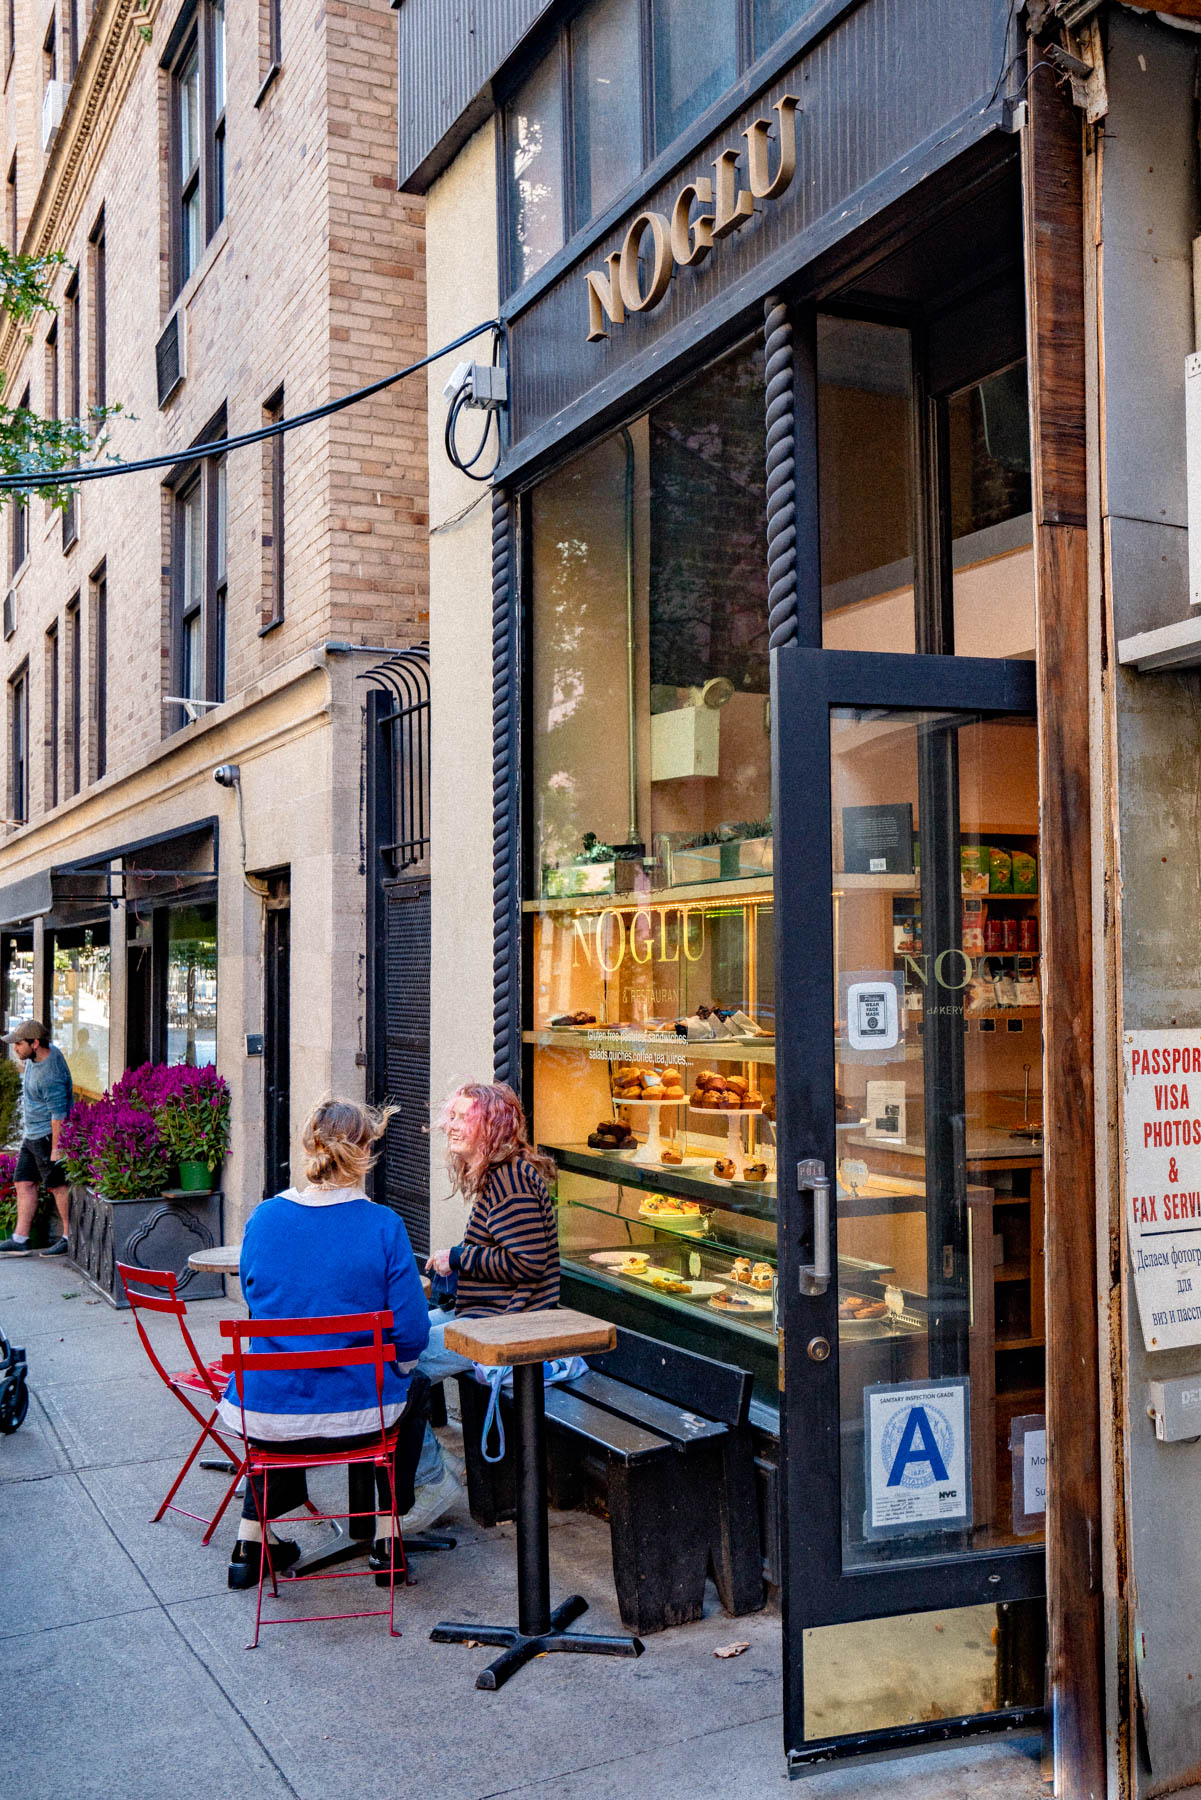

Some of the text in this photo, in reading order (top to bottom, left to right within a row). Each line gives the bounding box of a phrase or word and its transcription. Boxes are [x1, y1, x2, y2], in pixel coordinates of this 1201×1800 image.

[584, 94, 800, 342] NOGLU
[572, 906, 708, 972] NOGLU
[901, 949, 1034, 990] NOGL
[630, 988, 685, 1004] RESTAURANT
[587, 1029, 607, 1041] Gluten
[607, 1029, 619, 1042] free
[1154, 1083, 1190, 1111] VISA
[1143, 1119, 1201, 1149] PHOTOS
[1168, 1156, 1179, 1183] &
[1132, 1195, 1158, 1224] FAX
[1136, 1248, 1170, 1272] Делаем
[1176, 1278, 1193, 1294] для
[1152, 1311, 1169, 1326] виз
[1169, 1309, 1177, 1324] и
[879, 1391, 954, 1404] SANITARY INSPECTION GRADE
[887, 1406, 950, 1487] A
[938, 1490, 957, 1499] NYC
